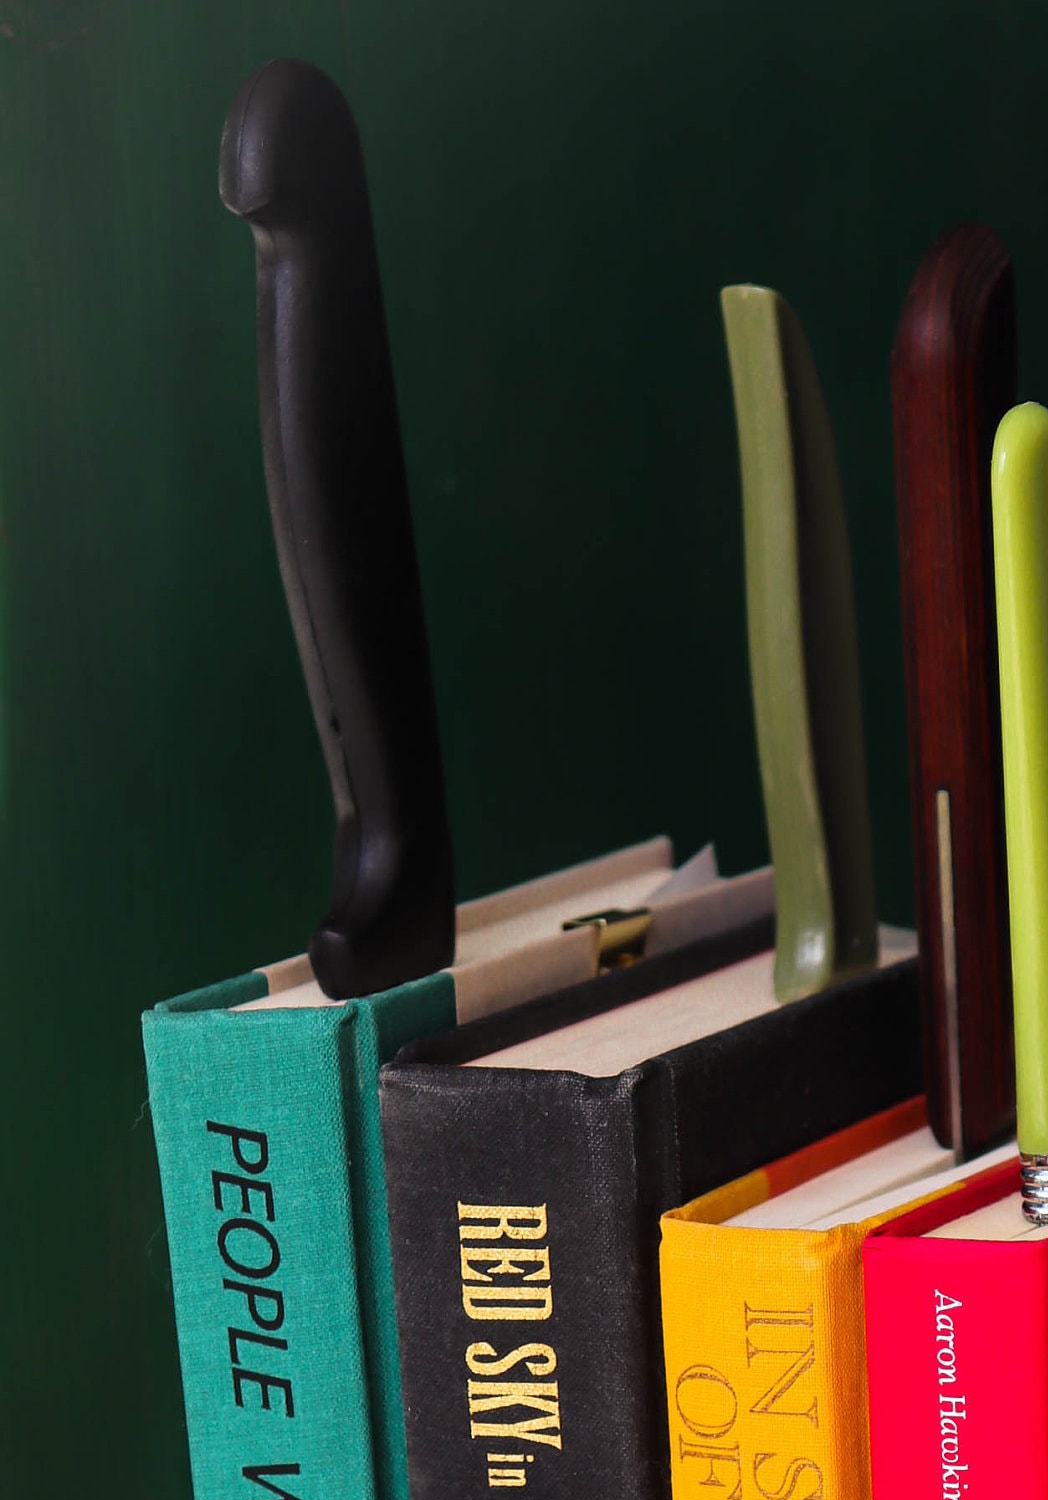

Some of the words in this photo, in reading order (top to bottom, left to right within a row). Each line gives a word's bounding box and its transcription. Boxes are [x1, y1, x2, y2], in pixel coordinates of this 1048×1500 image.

[205, 1119, 295, 1419] PEOPLE
[457, 1200, 553, 1321] RED
[743, 1300, 820, 1430] IN
[934, 1288, 963, 1386] Aaron
[465, 1341, 562, 1450] SKY
[487, 1453, 535, 1487] in
